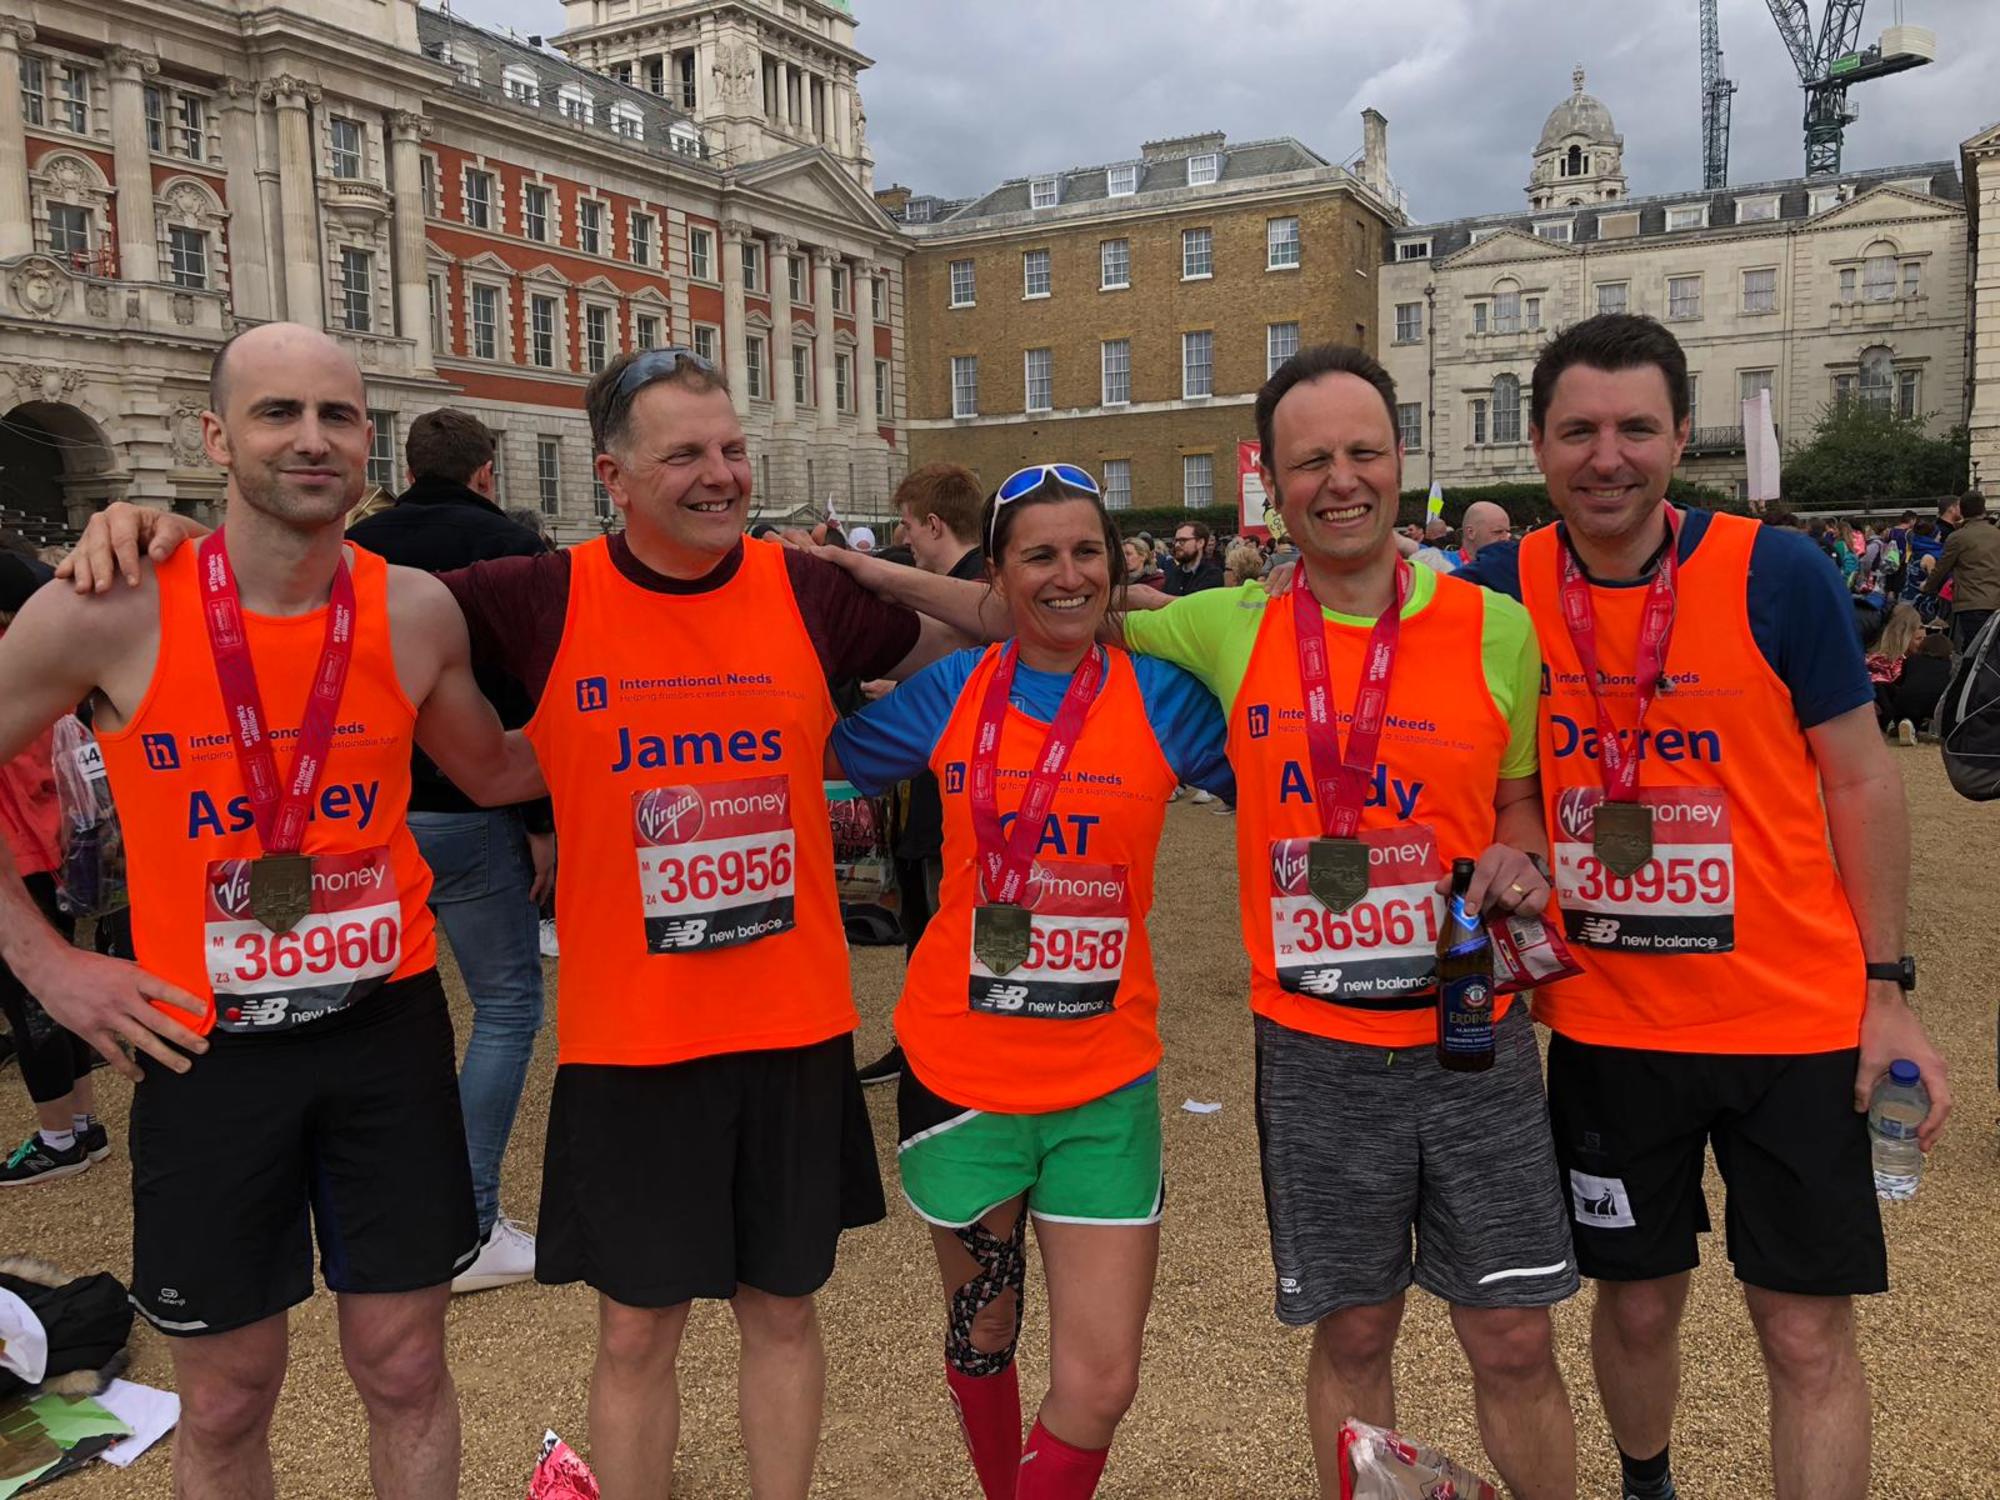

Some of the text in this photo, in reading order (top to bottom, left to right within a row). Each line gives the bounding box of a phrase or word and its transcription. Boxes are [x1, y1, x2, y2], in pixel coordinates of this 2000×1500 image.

[619, 672, 772, 691] International Needs
[1385, 716, 1437, 733] Needs
[611, 727, 783, 773] James
[1077, 772, 1122, 786] Needs
[1280, 760, 1424, 821] Ady
[641, 788, 786, 840] Virgin money
[1368, 842, 1430, 867] oney
[658, 842, 792, 904] 36956
[1576, 857, 1731, 904] 36959
[1049, 878, 1124, 902] money
[1293, 896, 1437, 953] 36961
[213, 936, 224, 948] M
[709, 928, 736, 944] new
[1622, 935, 1651, 946] new
[1655, 935, 1718, 948] balance
[234, 917, 398, 982] 36960
[215, 973, 230, 984] Z3
[1344, 980, 1373, 992] new
[291, 1008, 324, 1024] new
[1028, 1001, 1056, 1013] new
[1058, 1000, 1105, 1013] balance
